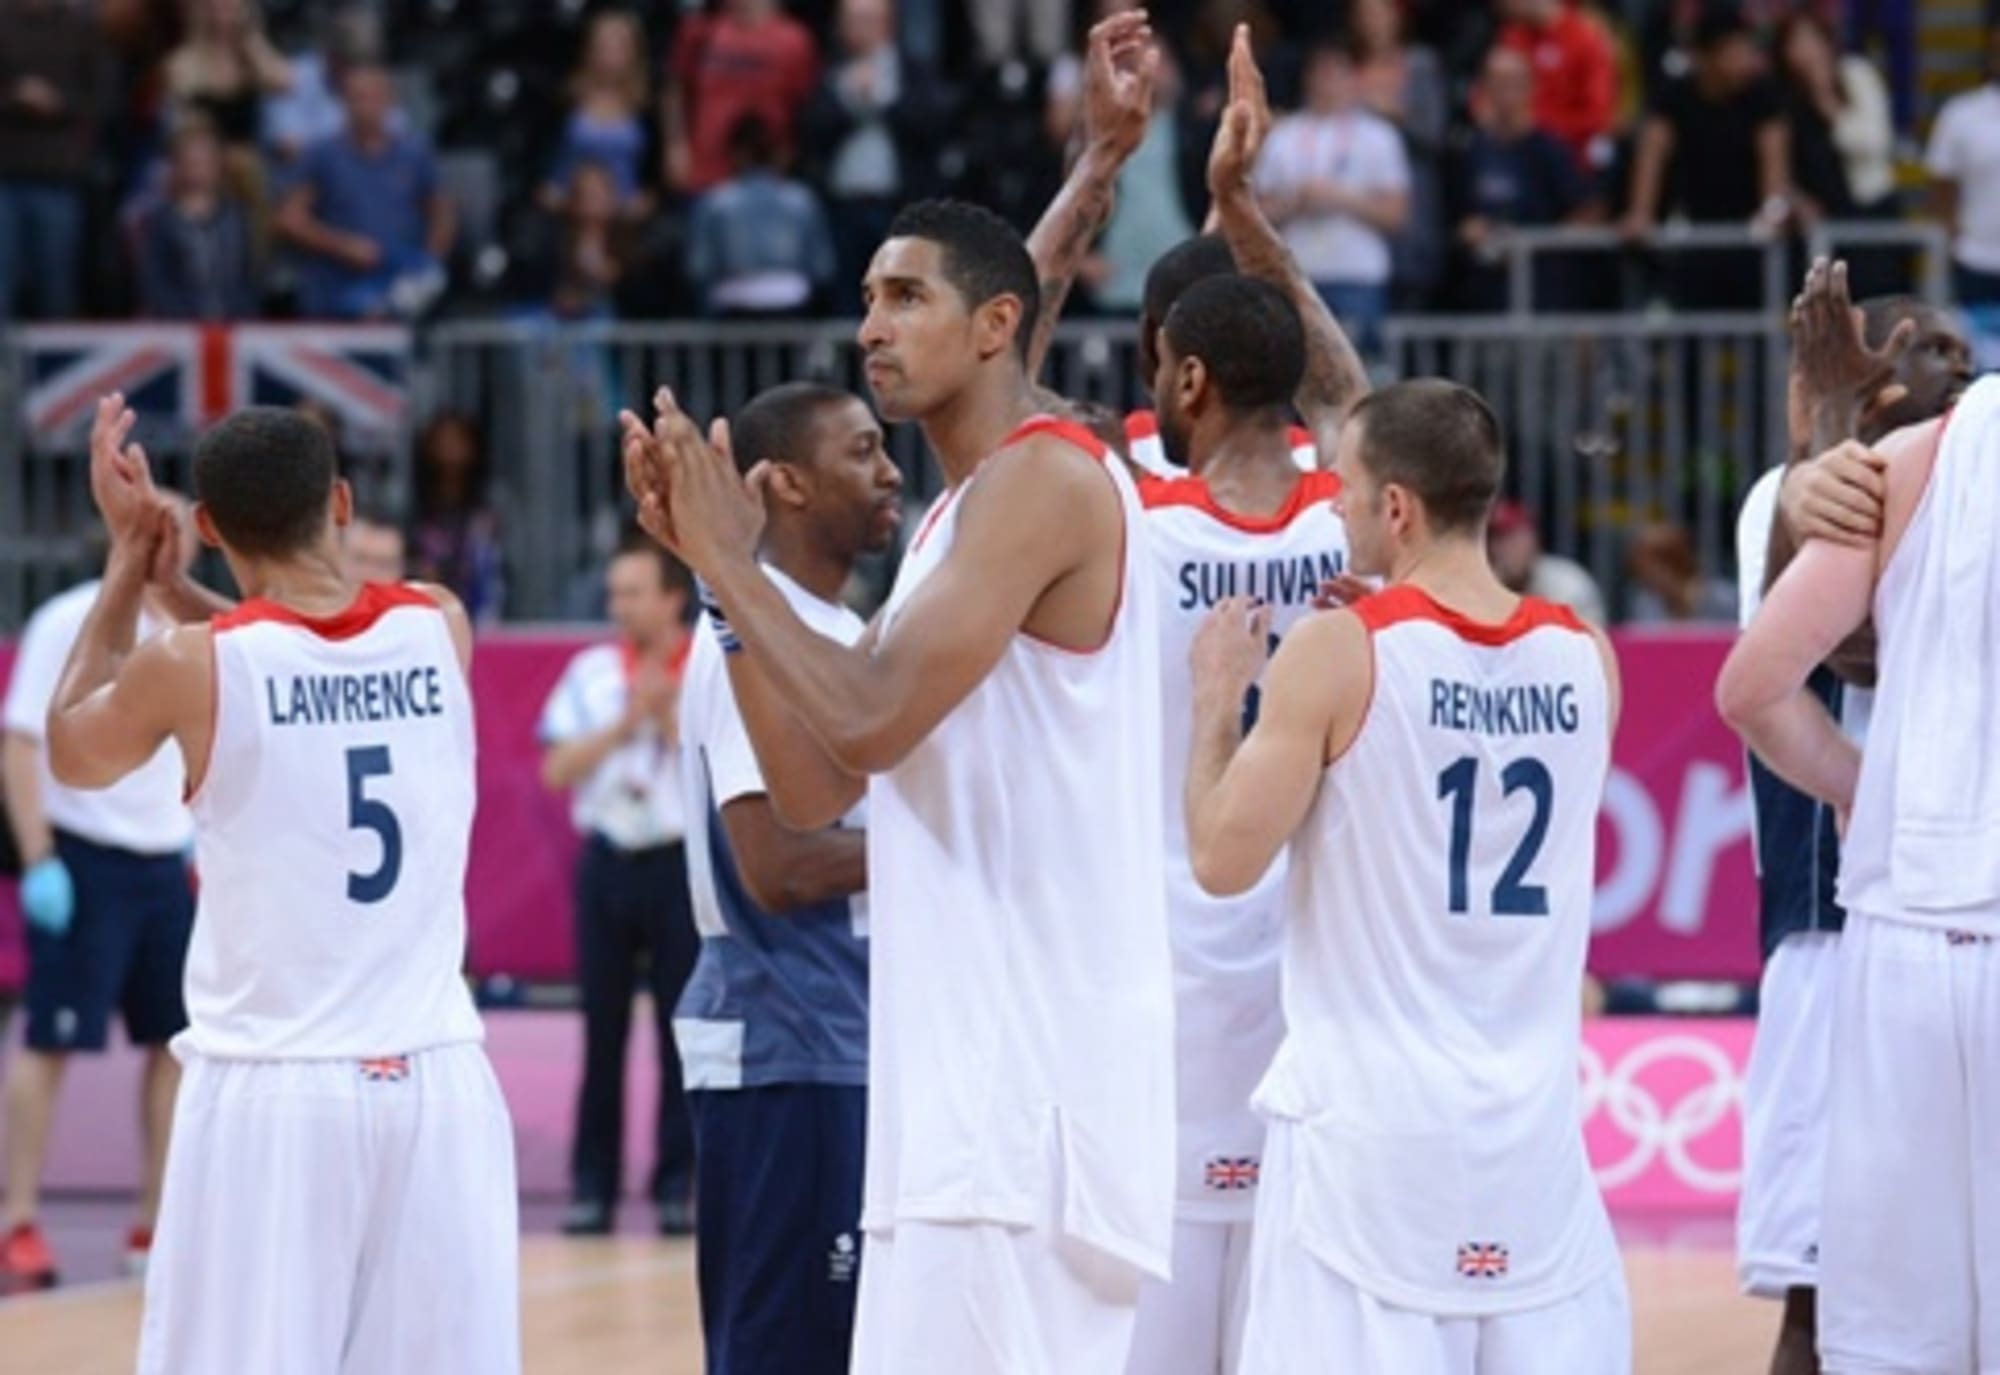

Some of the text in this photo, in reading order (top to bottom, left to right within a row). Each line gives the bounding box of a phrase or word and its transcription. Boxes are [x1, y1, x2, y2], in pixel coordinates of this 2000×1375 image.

[266, 666, 443, 725] LAWRENCE
[345, 745, 403, 904] 5
[1437, 755, 1554, 916] 12
